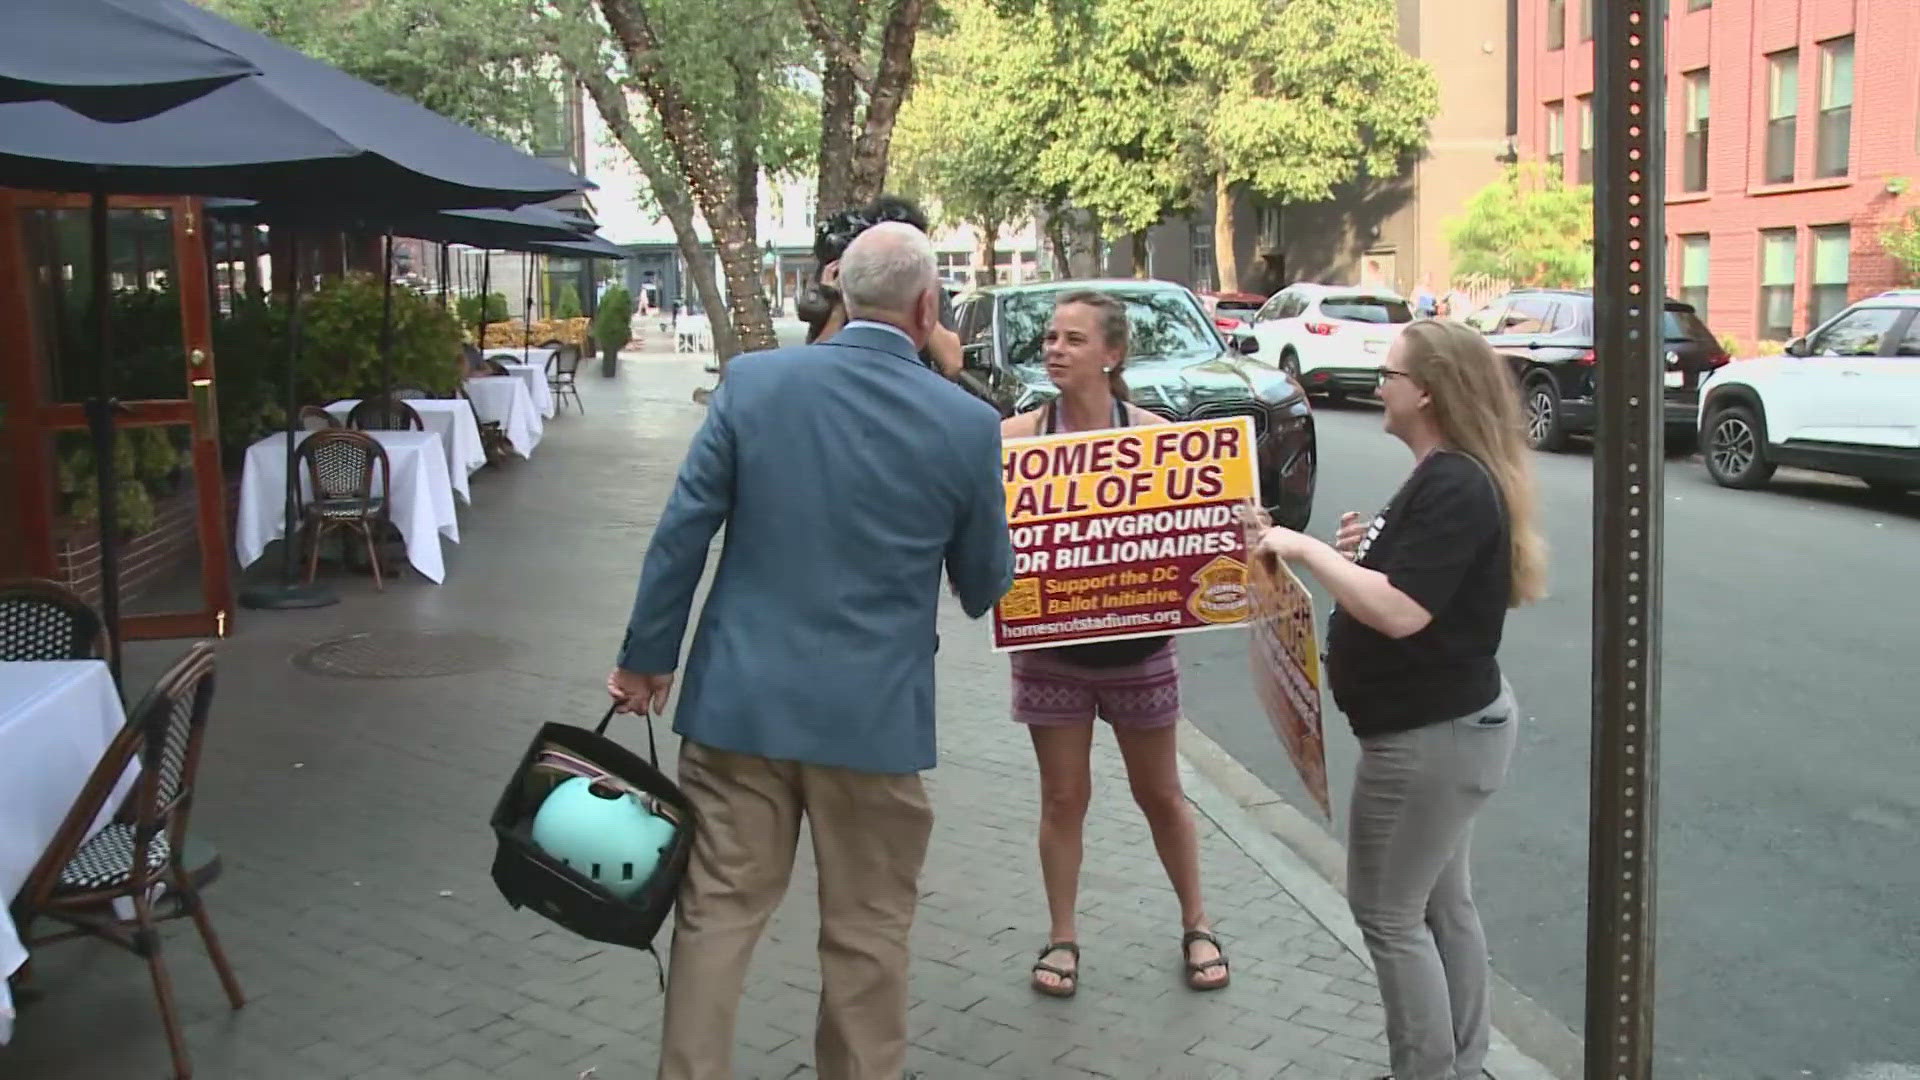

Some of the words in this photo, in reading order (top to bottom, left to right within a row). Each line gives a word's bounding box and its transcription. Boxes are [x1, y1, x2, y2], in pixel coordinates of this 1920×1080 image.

[1154, 427, 1240, 467] FOR
[1011, 480, 1089, 519] ALL
[1096, 472, 1153, 508] OF
[1166, 465, 1223, 501] US
[1009, 525, 1049, 548] OT
[1053, 504, 1246, 544] PLAYGROUNDS
[1014, 551, 1050, 574] OR
[1055, 531, 1243, 570] BILLIONAIRES.
[1045, 574, 1116, 594] Support
[1119, 570, 1149, 585] the
[1152, 566, 1180, 582] DC
[1048, 594, 1098, 614] Ballot
[1103, 587, 1183, 608] Initiative.
[1001, 610, 1181, 638] homesnotstadiums.org
